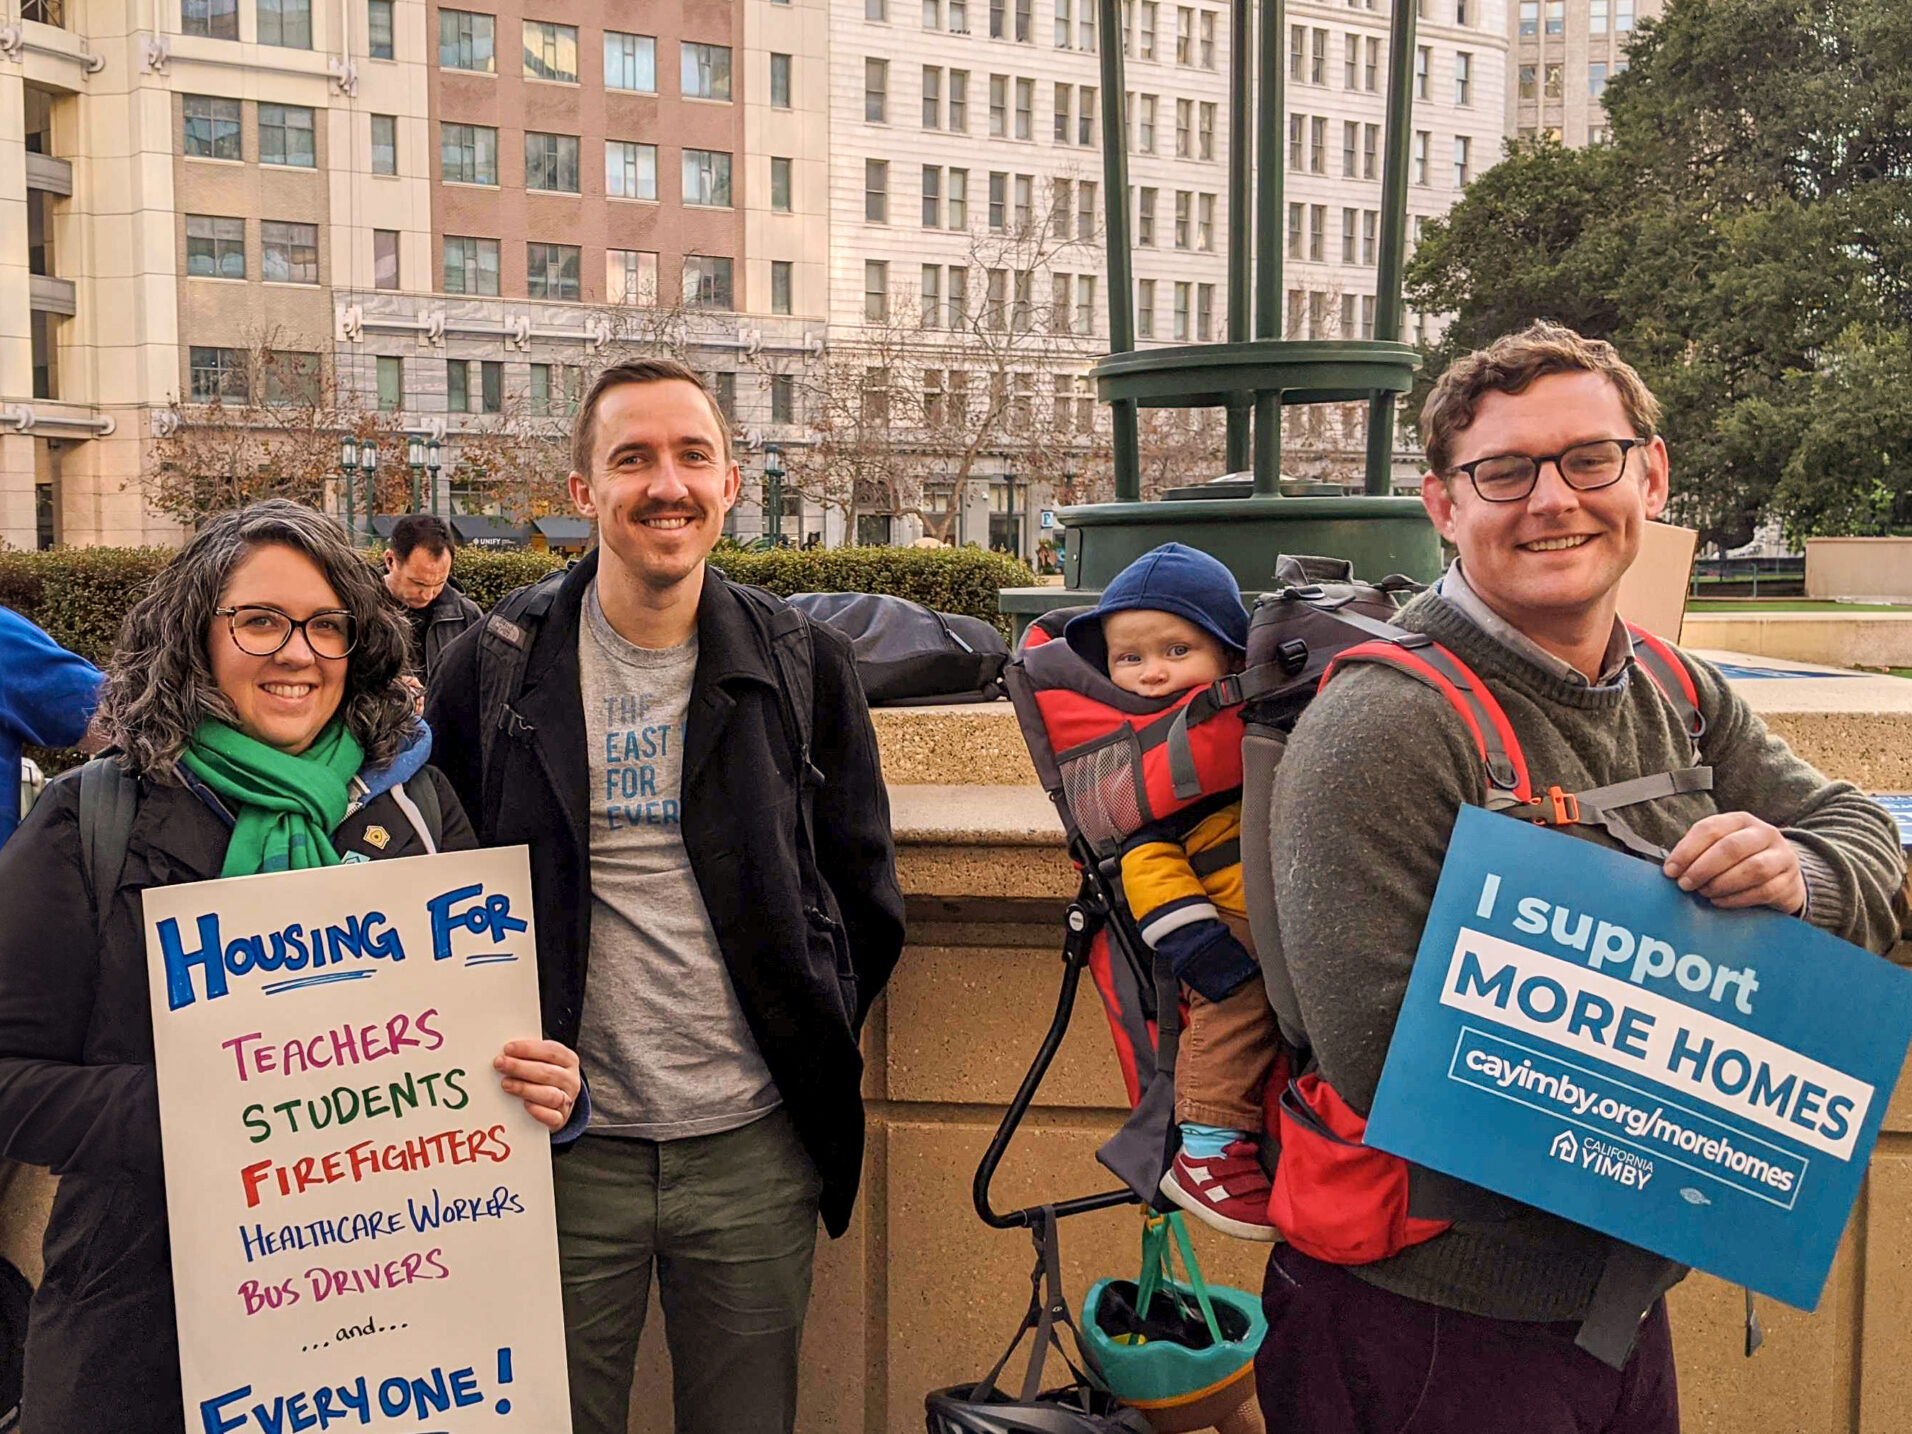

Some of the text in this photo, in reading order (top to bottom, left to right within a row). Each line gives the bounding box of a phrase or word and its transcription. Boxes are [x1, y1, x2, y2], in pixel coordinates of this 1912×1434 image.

[603, 693, 654, 727] THE
[606, 725, 671, 763] EAST
[606, 765, 656, 800] FOR
[606, 800, 680, 830] EVER
[156, 883, 528, 1011] HOUSING FOR
[1476, 873, 1759, 1014] I support
[221, 1008, 445, 1082] TEACHERS
[1454, 951, 1855, 1141] MORE HOMES
[242, 1068, 469, 1143] STUDENTS
[1465, 1047, 1794, 1191] cayimby.org/morehomes
[240, 1124, 511, 1208] FIREFIGHTERS
[1582, 1147, 1653, 1190] YIMBY
[1583, 1137, 1654, 1173] CALIFORNIA
[239, 1186, 526, 1262] HEALTHCARE WORKERS
[237, 1248, 450, 1316] BUS DRIVERS
